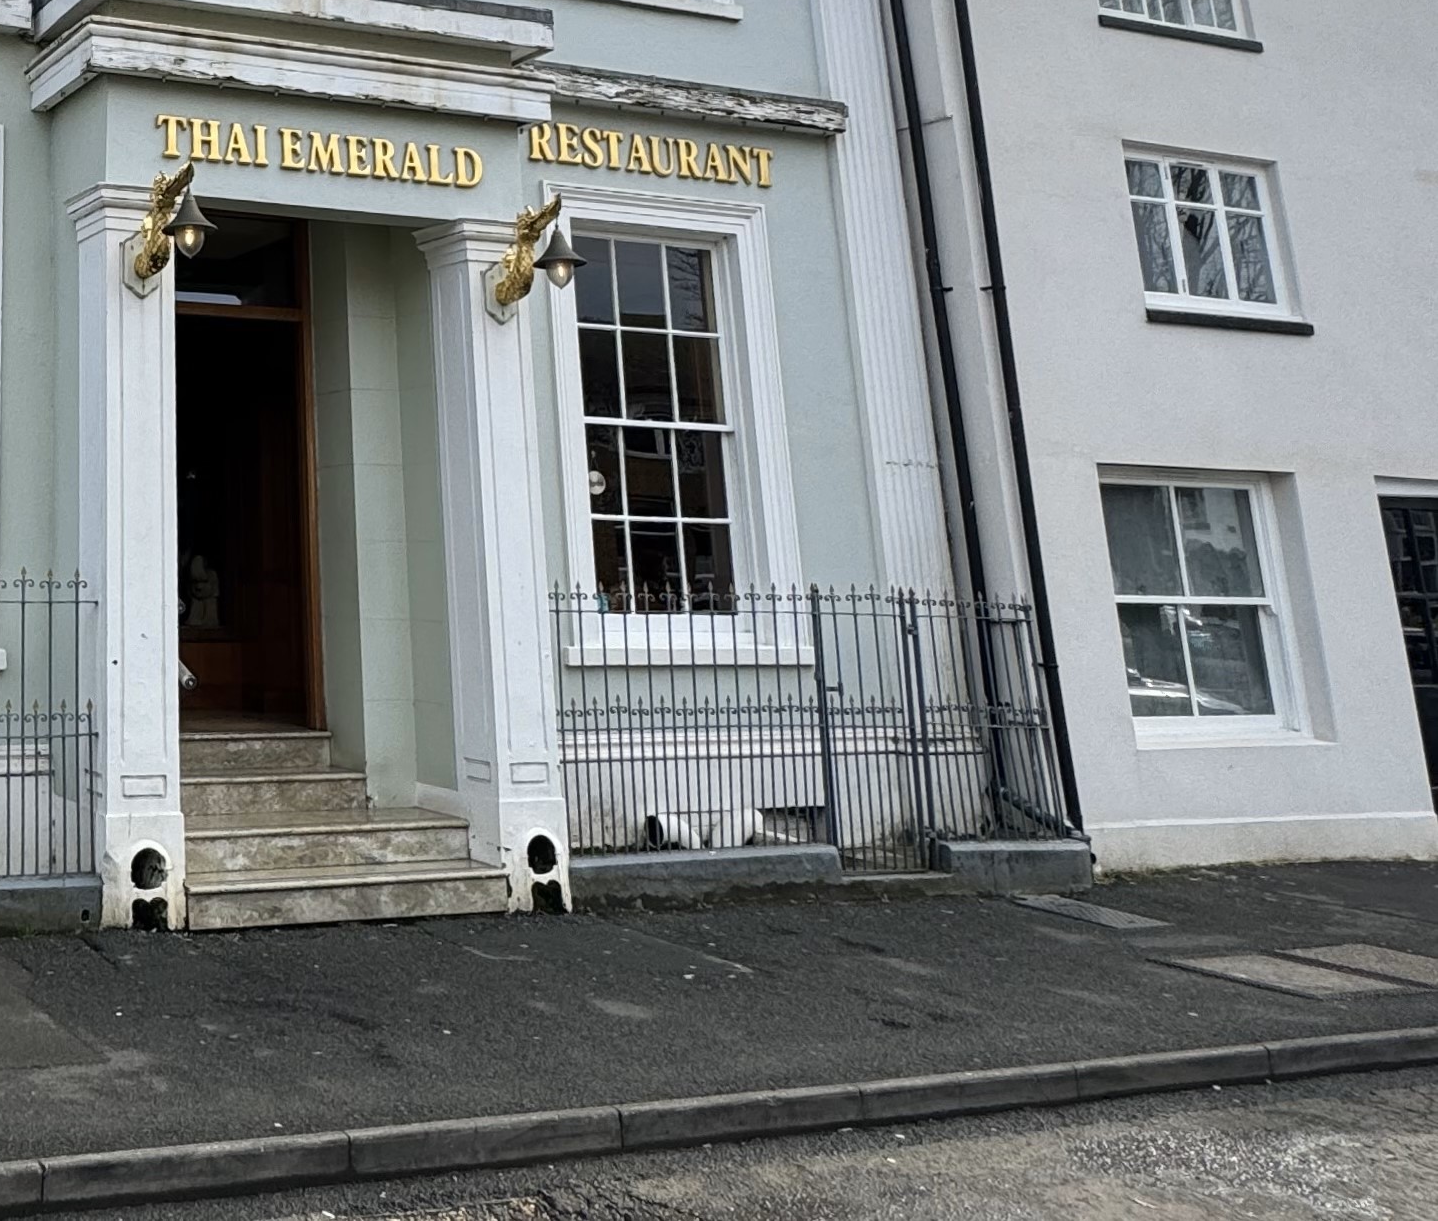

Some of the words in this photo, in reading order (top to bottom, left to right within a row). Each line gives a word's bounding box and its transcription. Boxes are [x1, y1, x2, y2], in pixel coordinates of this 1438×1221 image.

[156, 113, 269, 167] THAI
[279, 127, 484, 188] EMERALD
[528, 121, 774, 188] RESTAURANT
